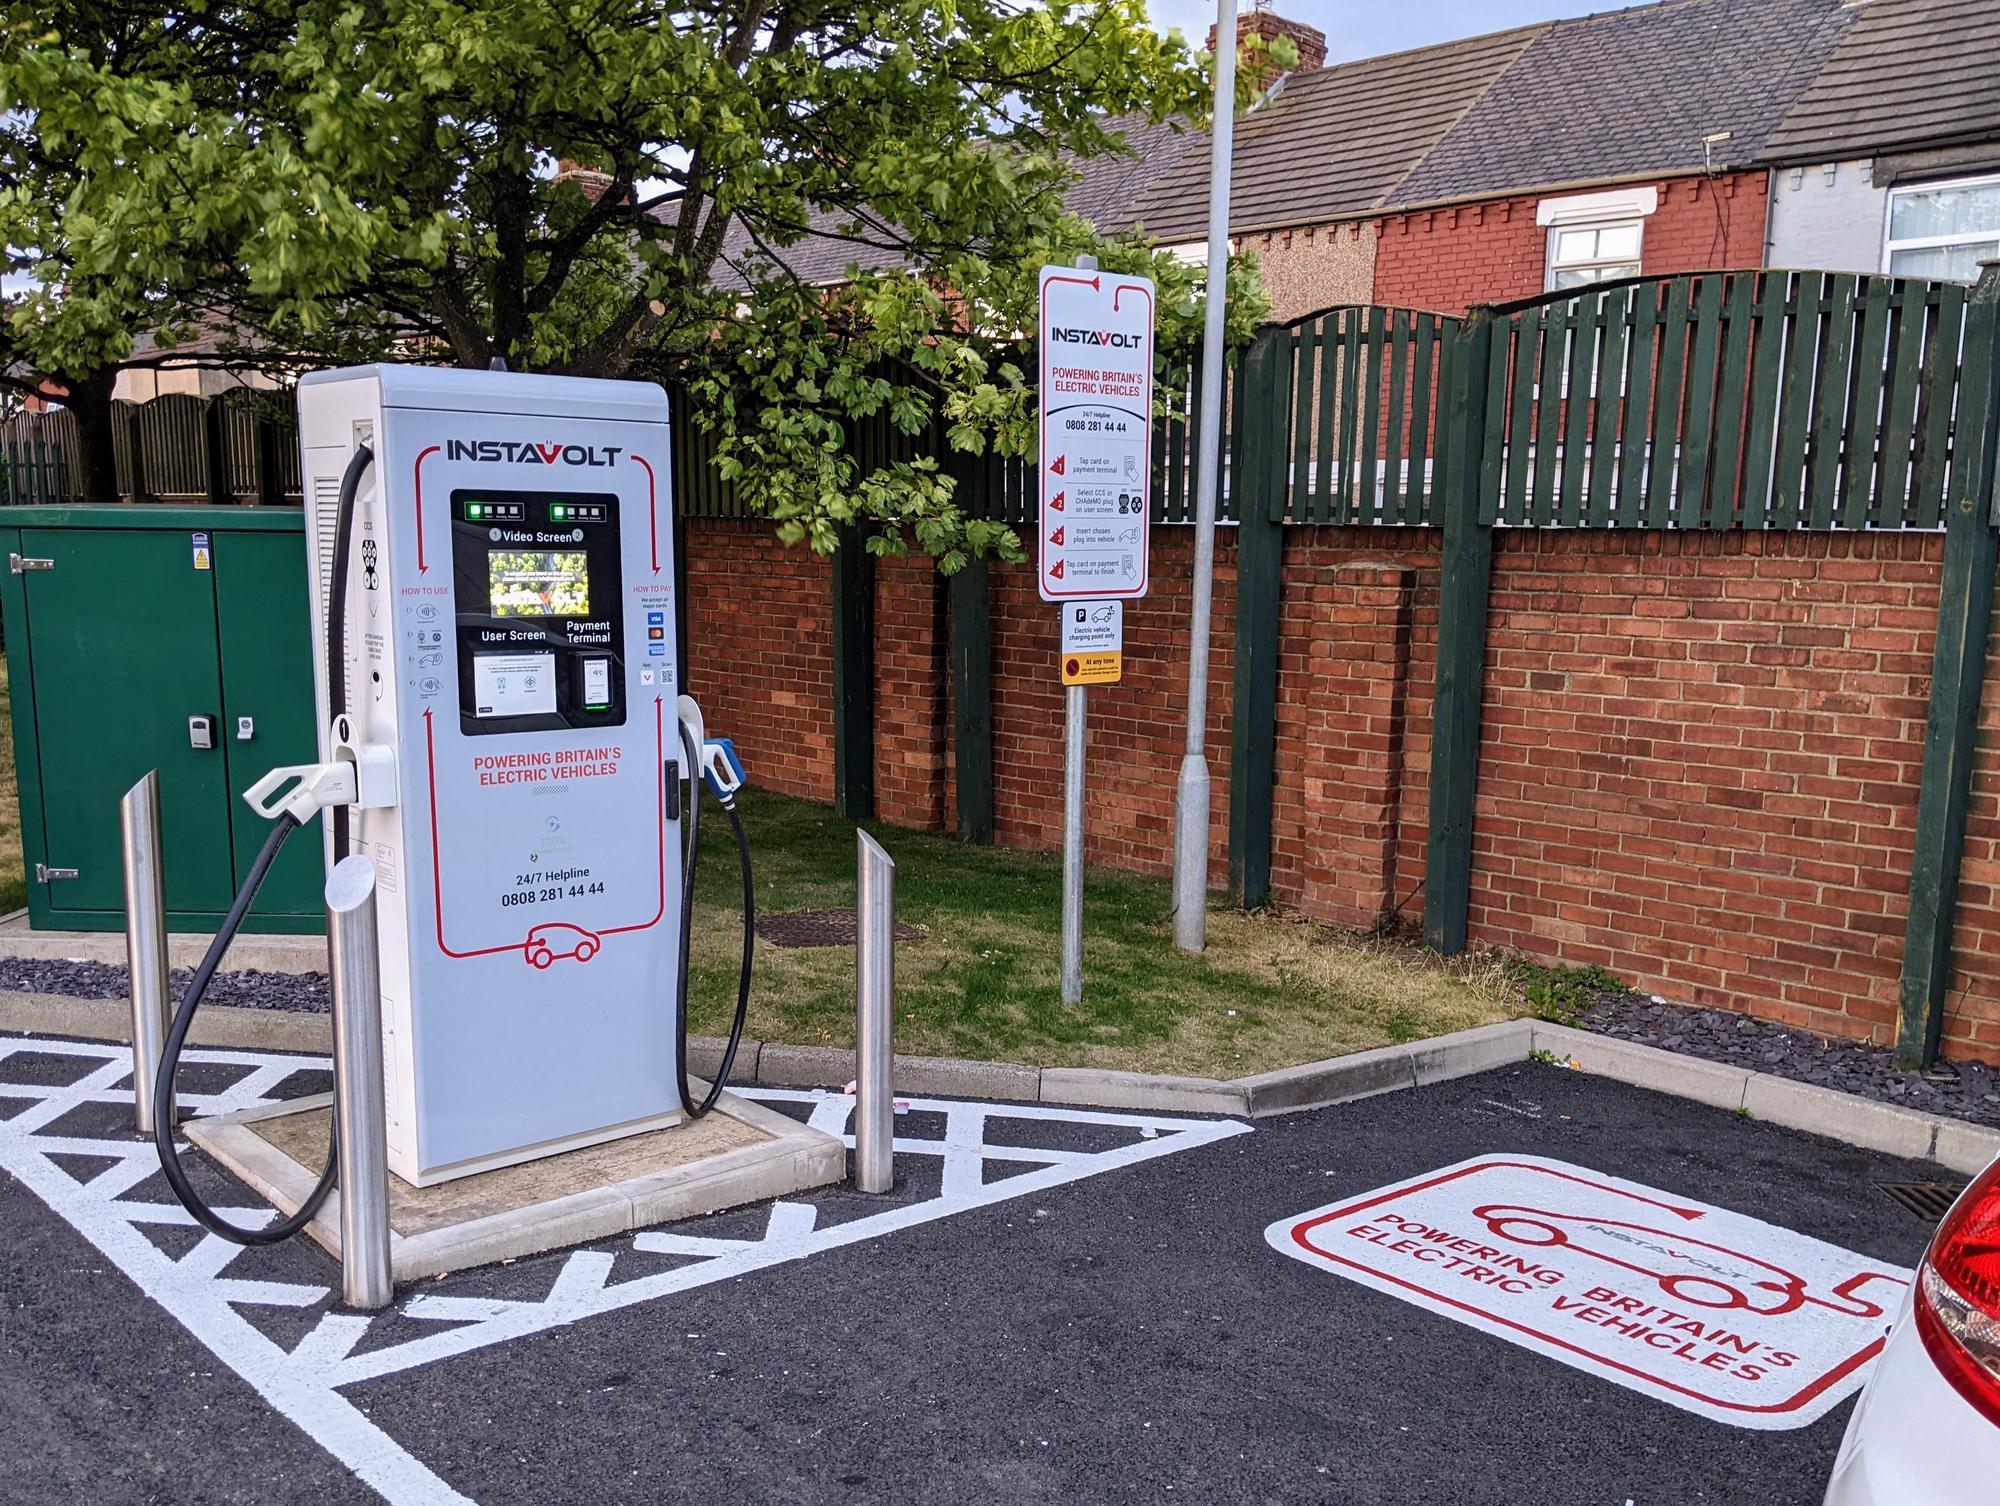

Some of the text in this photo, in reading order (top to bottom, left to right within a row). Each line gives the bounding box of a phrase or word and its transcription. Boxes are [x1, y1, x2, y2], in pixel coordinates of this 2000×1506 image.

[1052, 327, 1142, 349] INSTAVOLT
[1052, 367, 1143, 384] POWERING BRITAIN'S
[1055, 381, 1140, 397] ELECTRIC VEHICLES
[1082, 410, 1111, 419] 24/7 Helpline
[1065, 419, 1127, 433] 0808 281 44 44
[447, 439, 623, 467] INSTAVOLT
[1079, 457, 1088, 465] Tap
[1090, 457, 1102, 465] card
[1072, 466, 1118, 475] payment terminal
[1057, 499, 1063, 508] 2
[1102, 498, 1114, 506] plug
[502, 530, 533, 542] Video
[536, 531, 572, 543] Screen
[1092, 527, 1111, 535] chosen
[1057, 534, 1062, 543] 3
[1073, 535, 1115, 544] plug into vehicle
[1066, 560, 1076, 568] Tap
[1076, 560, 1089, 568] card
[1097, 560, 1119, 568] payment
[1057, 567, 1062, 576] 4
[401, 586, 448, 595] HOW TO USE
[650, 585, 659, 593] TO
[566, 621, 610, 633] Payment
[481, 630, 546, 642] User Screen
[566, 632, 611, 643] Terminal
[474, 747, 622, 770] POWERING BRITAIN'S
[480, 762, 617, 786] ELECTRIC VEHICLES
[516, 867, 590, 886] 24/7 Helpline
[501, 881, 604, 907] 0808 281 44 44
[1585, 1224, 1750, 1279] INSTAVOLT
[1372, 1213, 1801, 1367] POWERING BRITAIN'S
[1346, 1224, 1769, 1381] ELECTRIC VEHICLES
